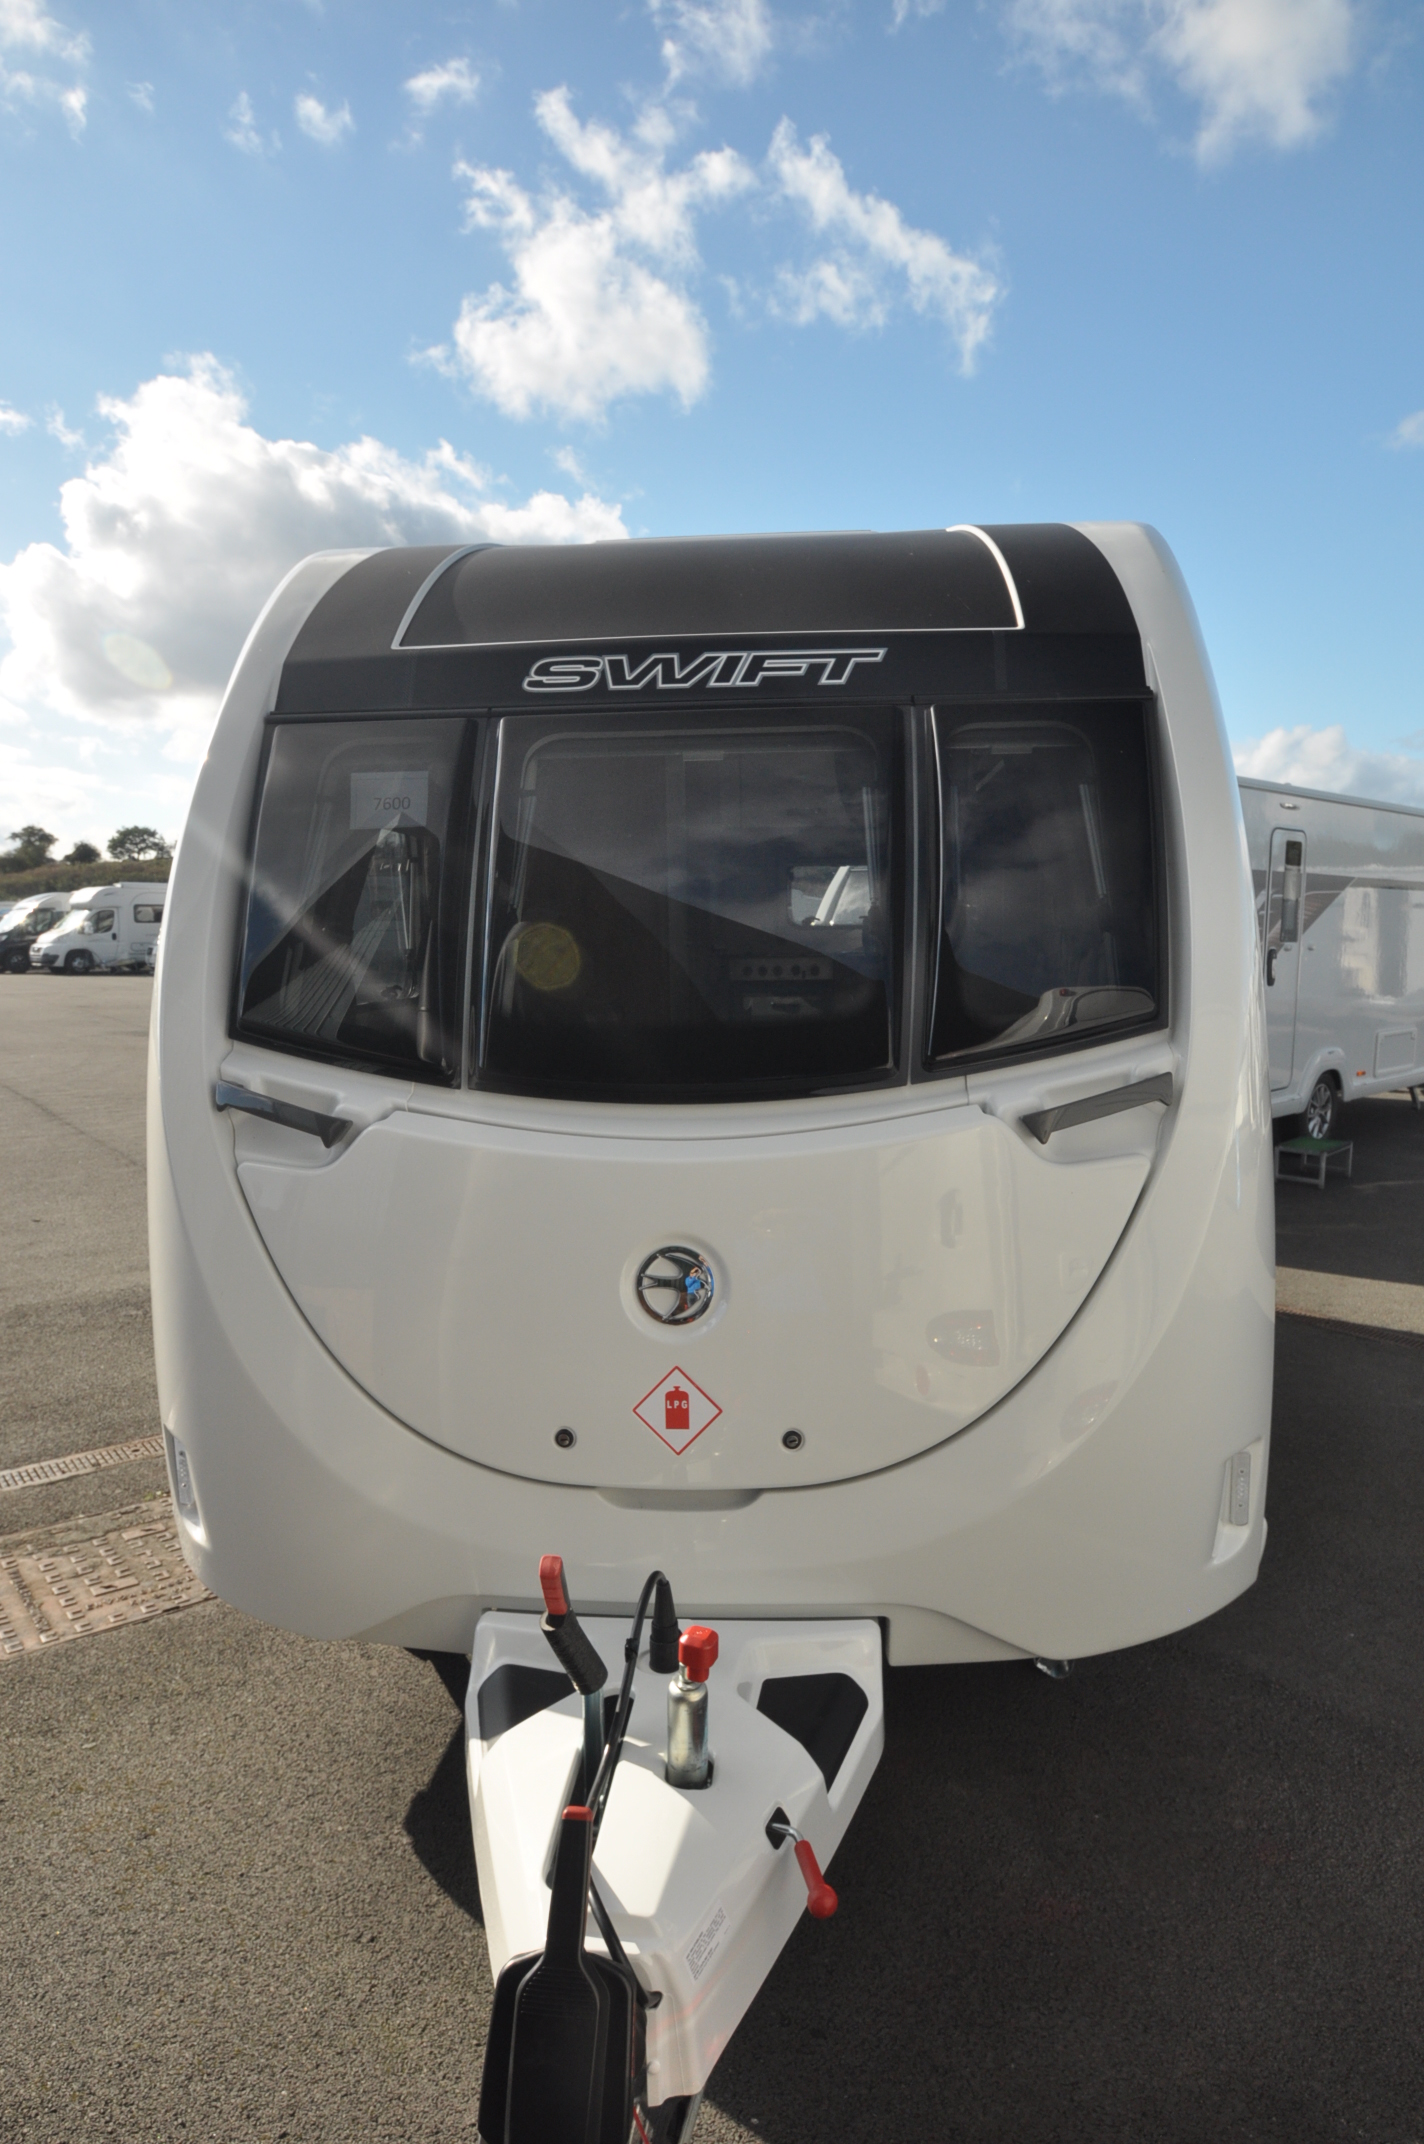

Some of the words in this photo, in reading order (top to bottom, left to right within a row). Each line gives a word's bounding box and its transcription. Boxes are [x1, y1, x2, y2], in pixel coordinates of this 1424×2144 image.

[522, 647, 888, 693] SWIFT
[373, 796, 411, 811] 7600
[666, 1400, 688, 1409] LPG
